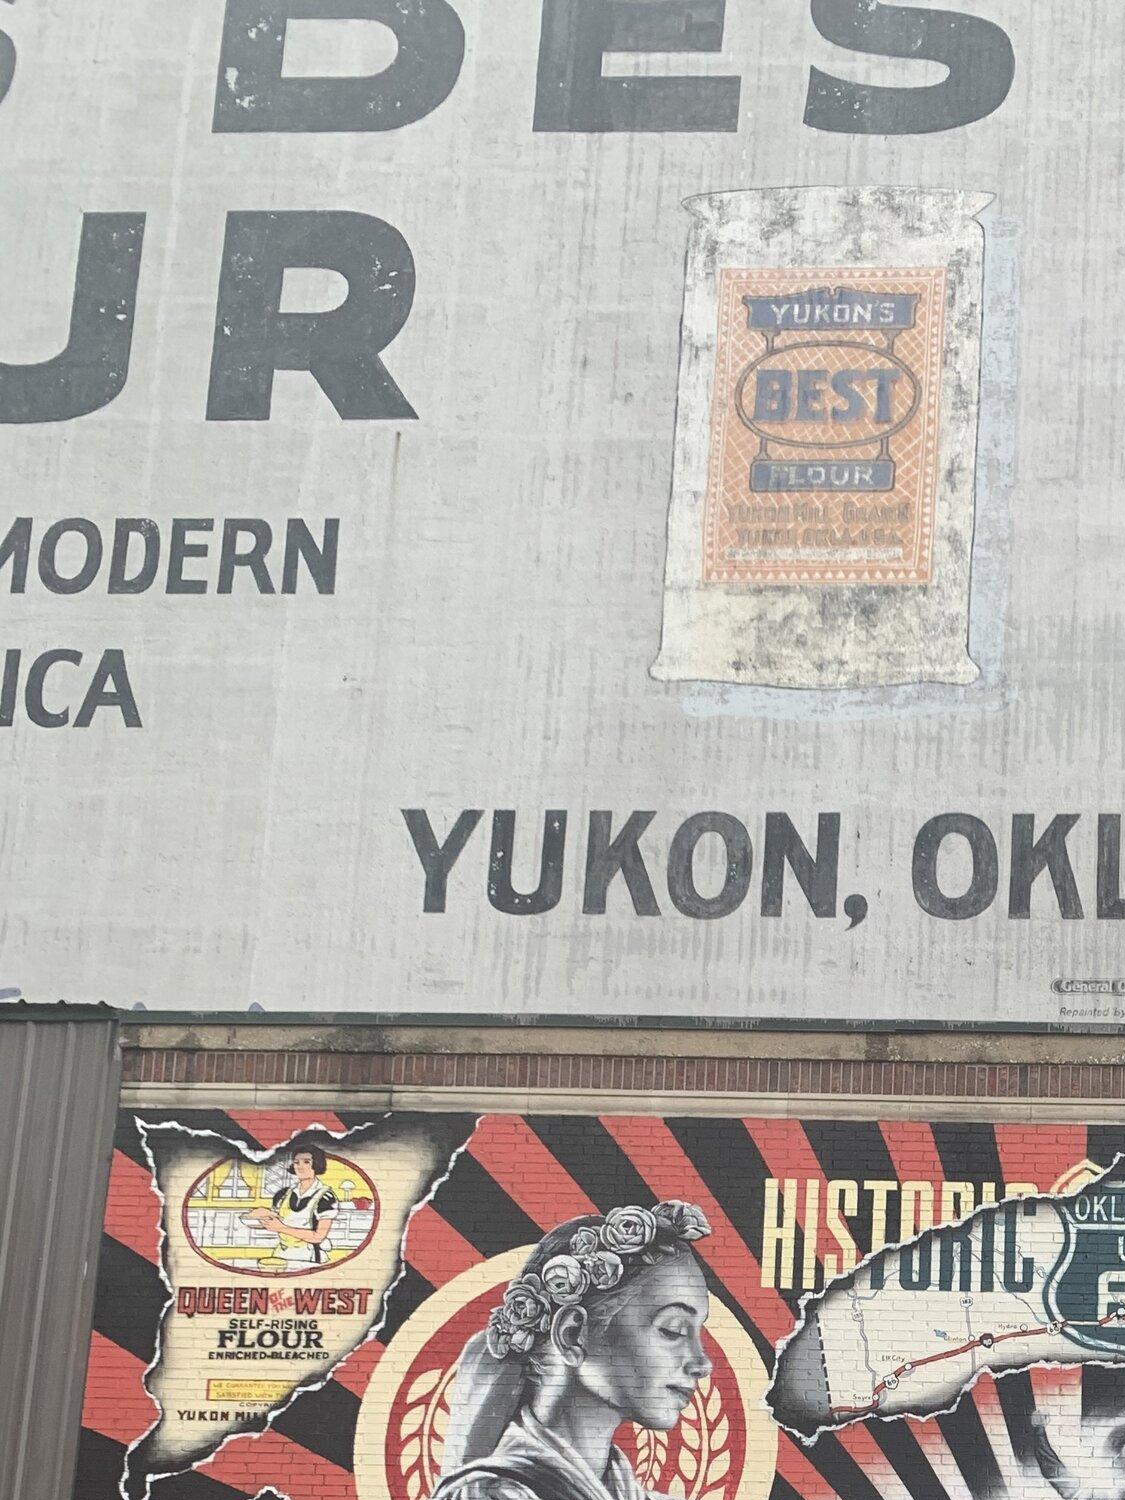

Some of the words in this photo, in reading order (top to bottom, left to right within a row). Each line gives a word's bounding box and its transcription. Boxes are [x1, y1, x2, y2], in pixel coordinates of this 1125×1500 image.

[769, 301, 896, 325] YUKON'S
[751, 368, 901, 424] BEST
[768, 465, 874, 486] FLOUR
[400, 808, 868, 931] YUKON,
[1060, 980, 1113, 992] General
[1058, 1007, 1110, 1018] Repainted
[760, 1177, 1039, 1294] HISTORIC
[176, 1286, 270, 1318] QUEEN
[293, 1288, 374, 1316] WEST
[228, 1318, 319, 1331] SELF-RISING
[216, 1330, 324, 1349] FLOUR
[207, 1351, 330, 1361] ENRICHED-BLEACHED
[176, 1410, 229, 1421] YUKON
